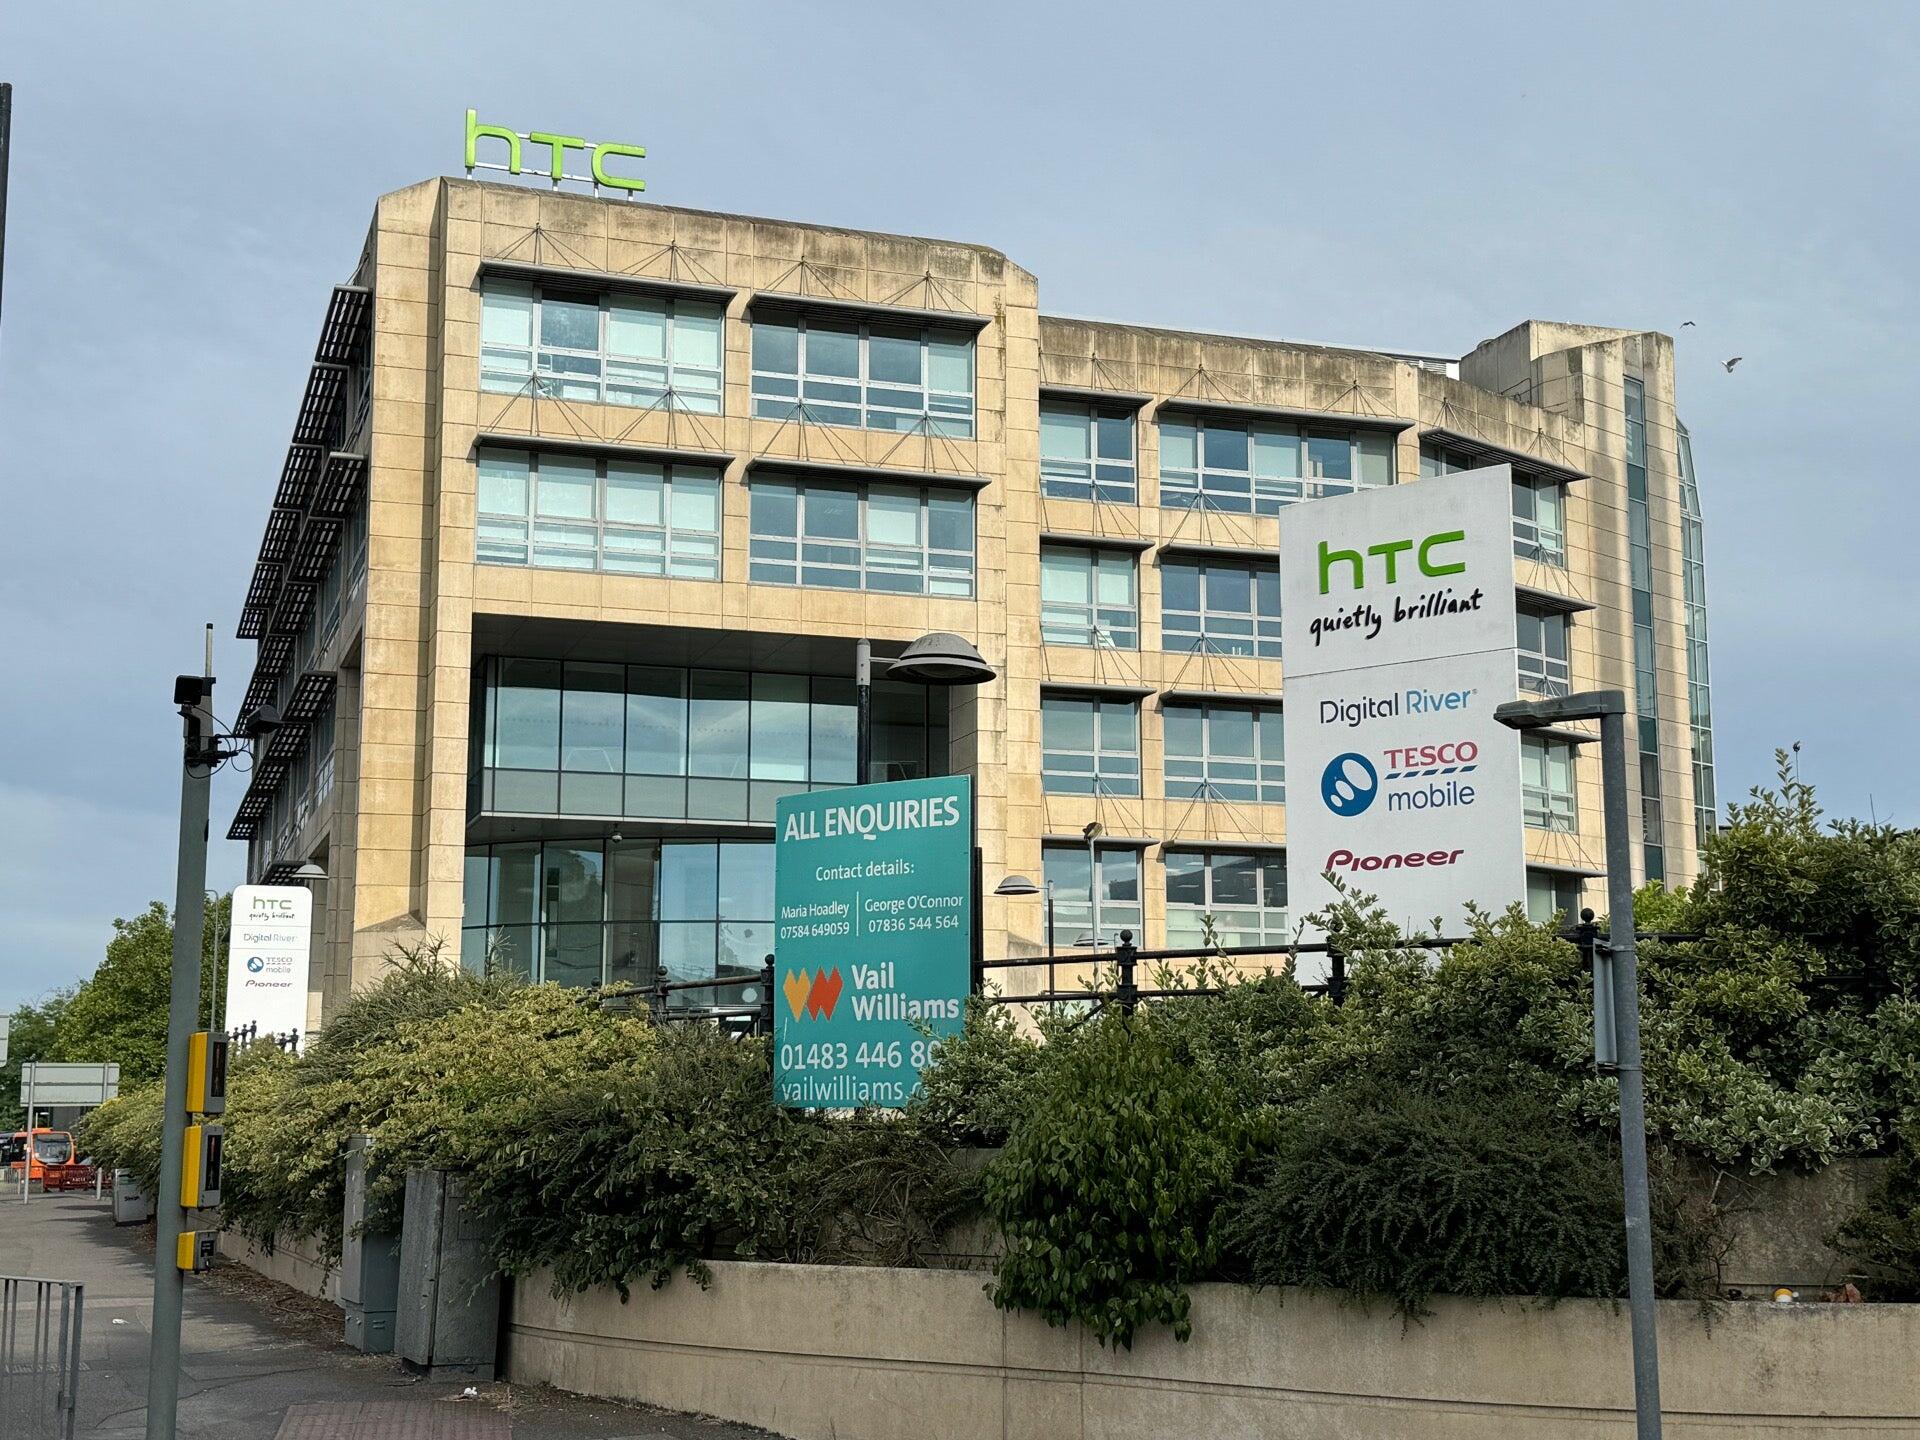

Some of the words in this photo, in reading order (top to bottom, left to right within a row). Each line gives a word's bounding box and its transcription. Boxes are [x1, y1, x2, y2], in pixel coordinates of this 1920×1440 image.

[1309, 604, 1383, 647] quietly
[1394, 588, 1484, 624] brilliant
[1320, 692, 1400, 728] Digital
[1384, 741, 1478, 770] TESCO
[1388, 780, 1475, 812] mobile
[783, 811, 821, 842] ALL
[825, 795, 960, 841] ENQUIRIES
[815, 862, 863, 881] Contact
[865, 859, 915, 877] details:
[1325, 849, 1465, 873] Pioneer
[781, 906, 807, 919] Maria
[809, 901, 850, 918] Hoadley
[864, 898, 906, 915] George
[907, 895, 963, 910] O'Connor
[780, 924, 810, 939] 07584
[811, 922, 850, 937] 649059
[868, 918, 906, 933] 07836
[909, 916, 932, 931] 544
[935, 915, 959, 929] 564
[243, 933, 272, 943] Digital
[245, 979, 293, 988] Pioneer
[851, 961, 895, 990] Vail
[851, 993, 960, 1022] Williams
[780, 1042, 848, 1071] 01483
[855, 1040, 902, 1069] 446
[910, 1039, 943, 1069] 80
